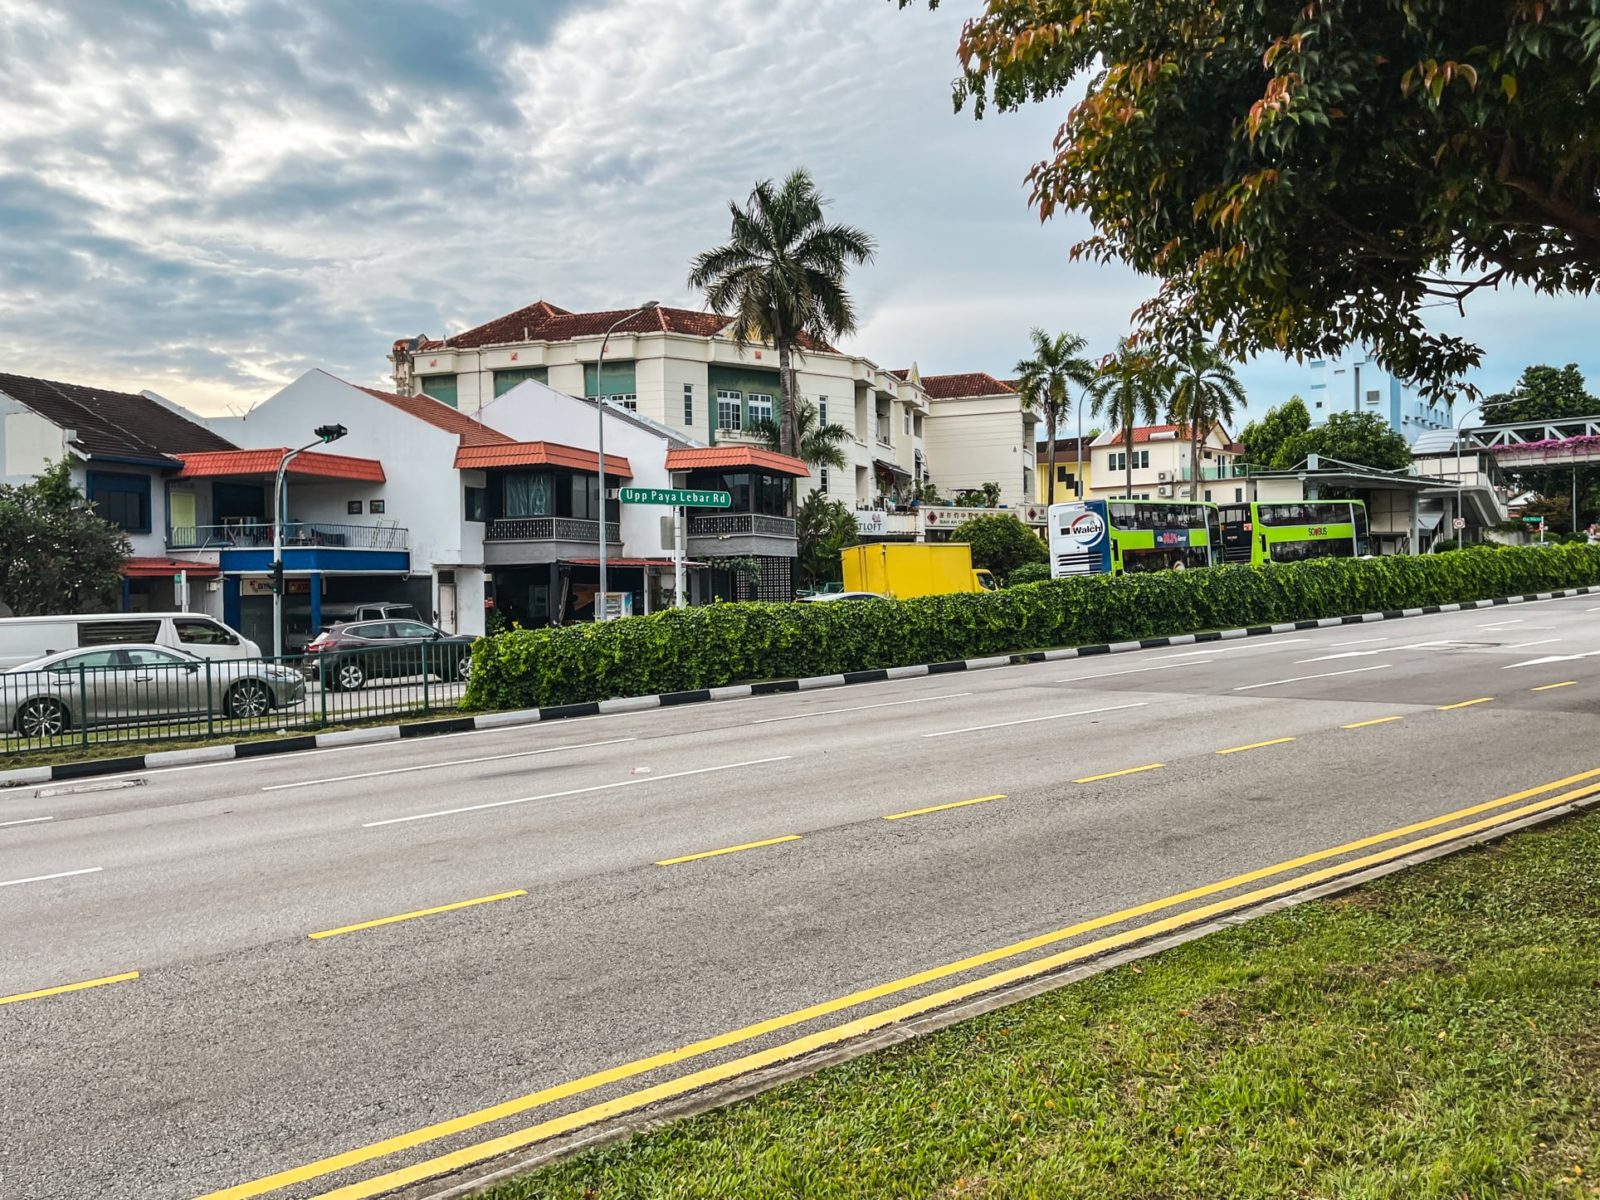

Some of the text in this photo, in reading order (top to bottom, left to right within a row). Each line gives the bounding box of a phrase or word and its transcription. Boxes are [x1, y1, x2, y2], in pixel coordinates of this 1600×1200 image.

[626, 490, 726, 503] Upp Paya Lebar Rd
[1072, 525, 1101, 535] Walch
